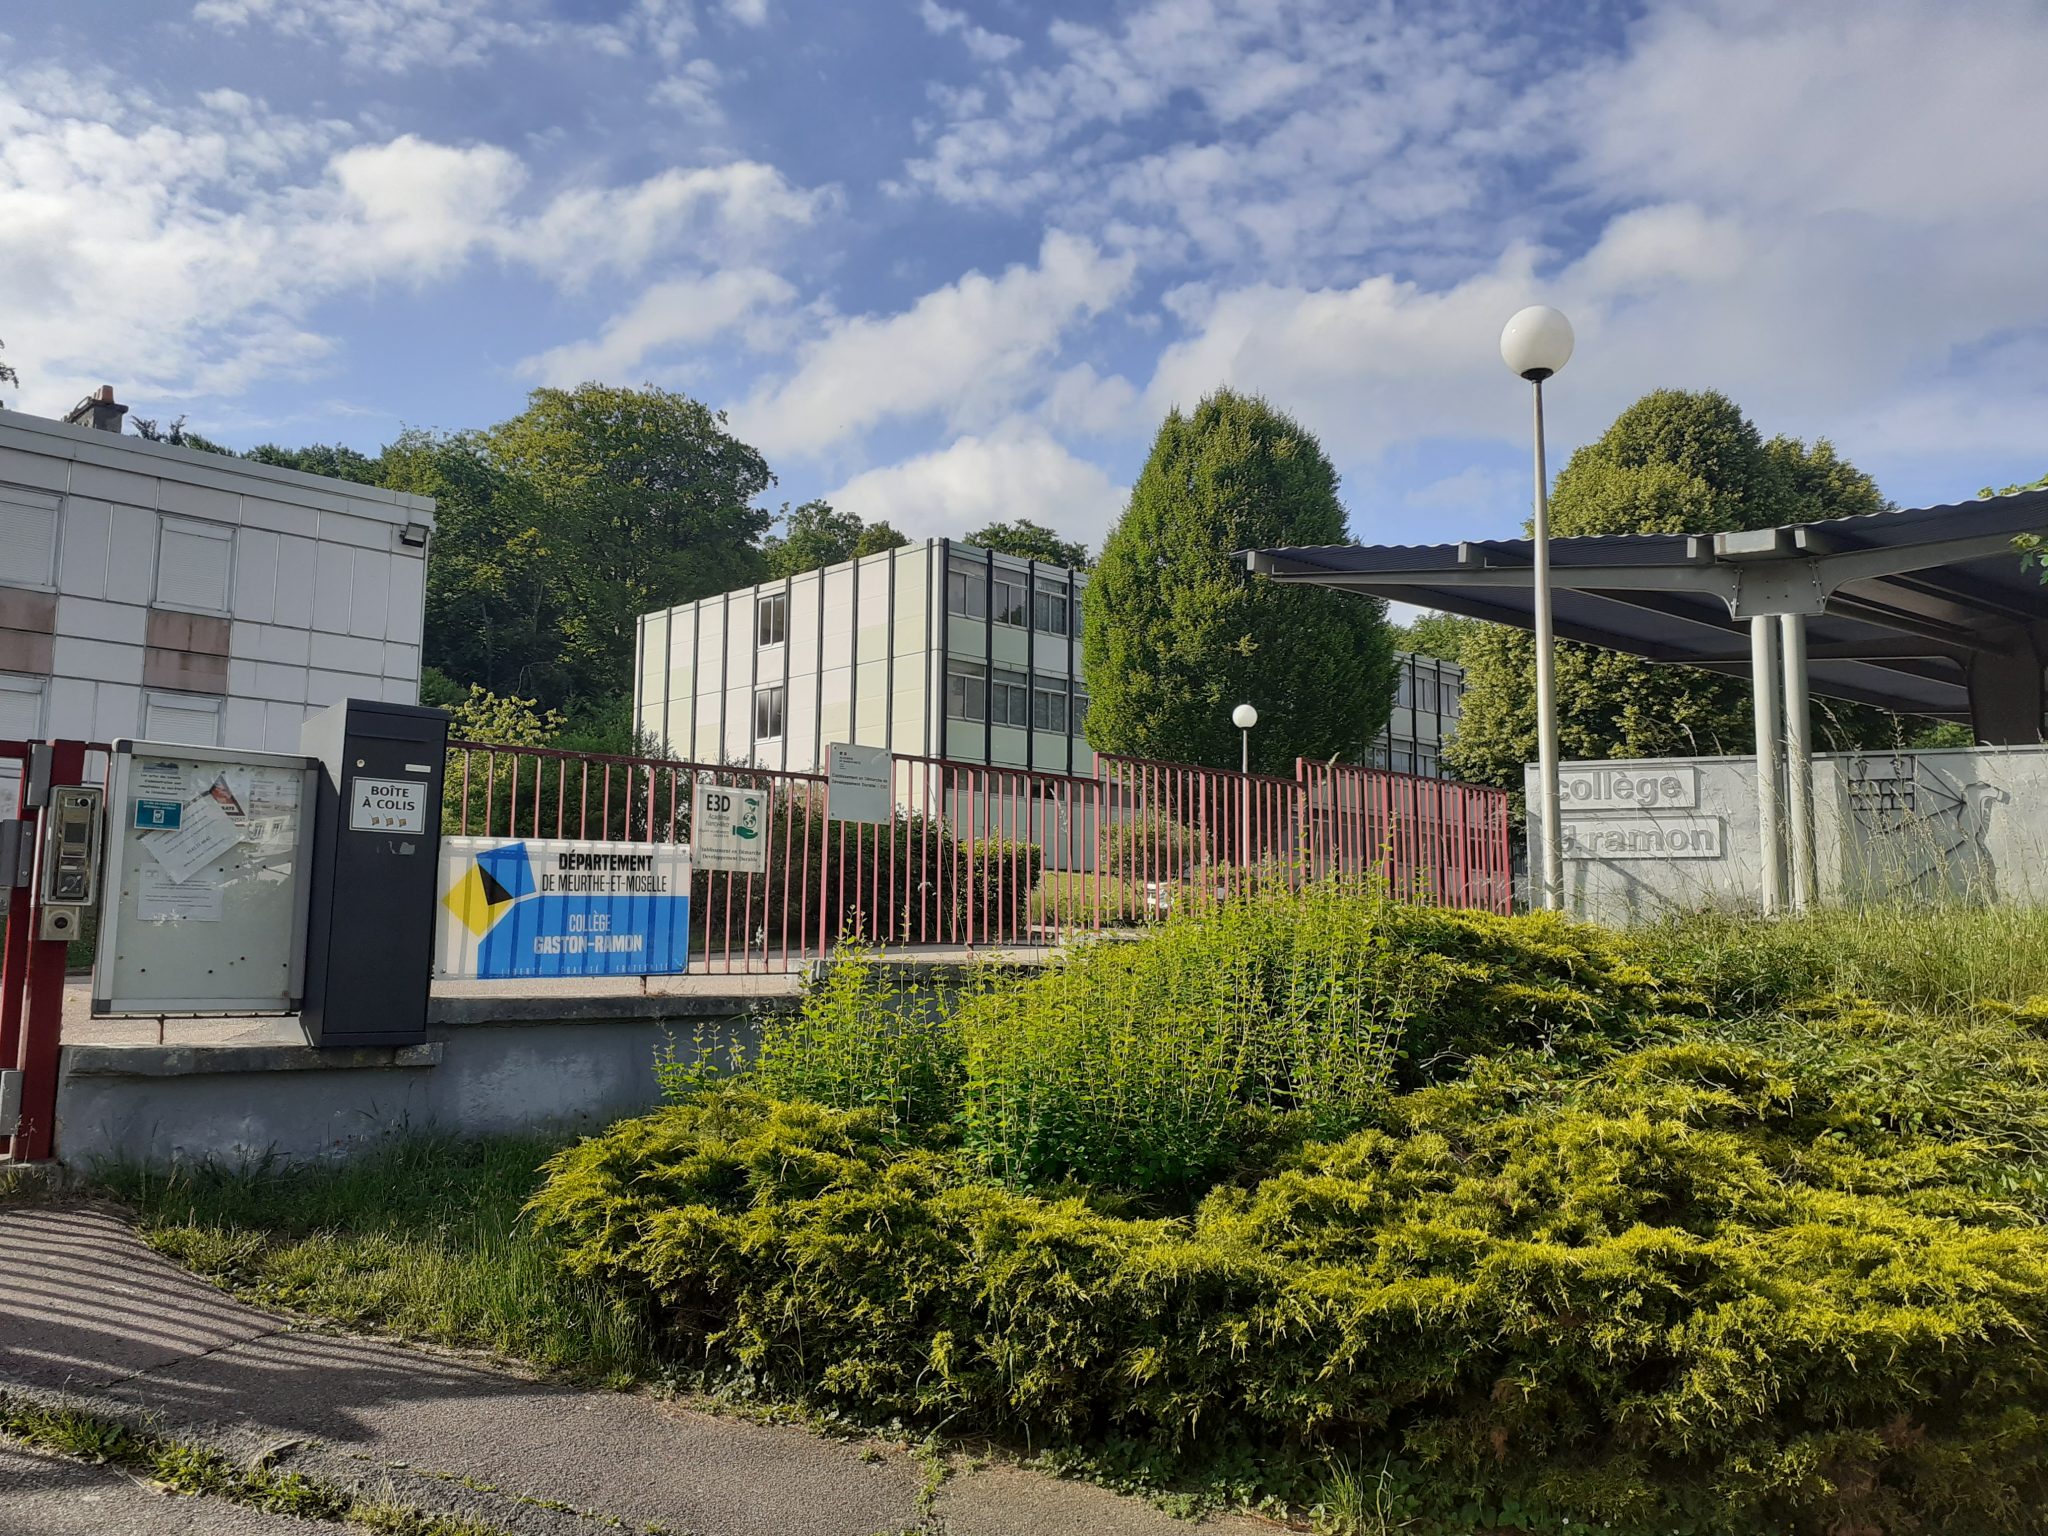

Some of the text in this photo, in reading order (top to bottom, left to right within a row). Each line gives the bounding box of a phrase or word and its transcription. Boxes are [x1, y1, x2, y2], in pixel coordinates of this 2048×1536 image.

[371, 785, 410, 798] BOÎTE
[362, 796, 415, 811] À COLIS
[706, 794, 731, 812] E3D
[1588, 828, 1714, 851] ramon
[558, 849, 653, 872] DÉPARTEMENT
[542, 874, 667, 892] DE MEURTHE-ET-MOSELLE
[569, 910, 612, 932] COLLÈGE
[533, 934, 643, 955] GASTON-RAMON
[561, 963, 600, 974] ÉGALTÉ
[616, 961, 669, 972] FRATERITÉ
